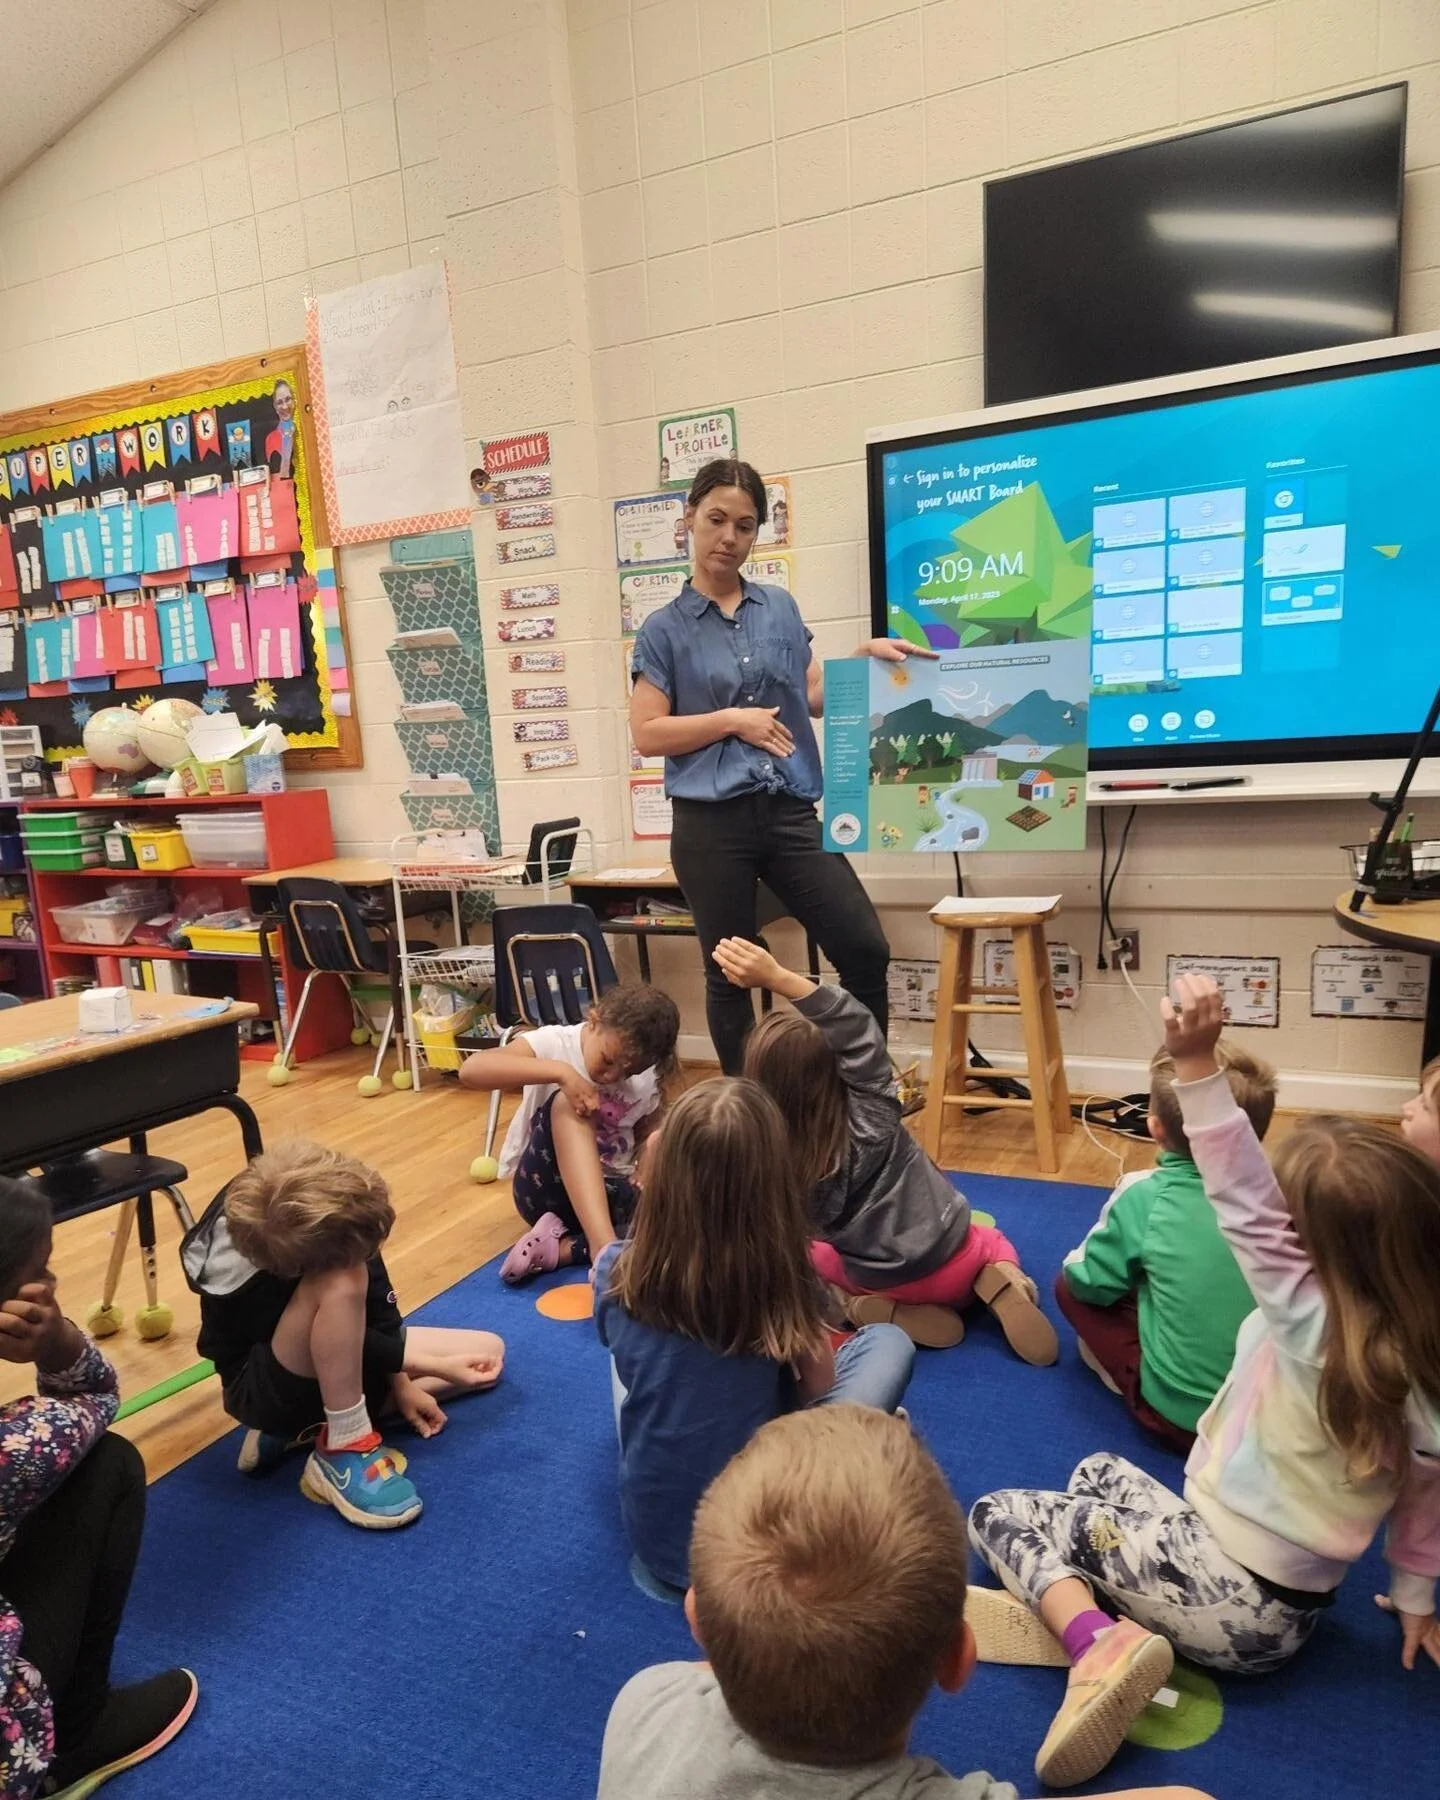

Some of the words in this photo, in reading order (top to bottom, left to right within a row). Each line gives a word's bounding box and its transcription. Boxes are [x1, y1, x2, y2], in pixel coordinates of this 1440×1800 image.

[486, 438, 546, 468] SCHEDULE
[916, 470, 940, 488] Sign
[942, 467, 954, 479] in
[958, 463, 970, 478] to
[973, 454, 1038, 481] personalize
[916, 496, 943, 514] your
[945, 485, 986, 506] SMART
[988, 480, 1024, 500] Board
[514, 544, 537, 556] Snack
[918, 557, 973, 586] 9:09
[979, 550, 1024, 579] AM
[517, 624, 537, 634] Lunch
[525, 657, 557, 668] Reading
